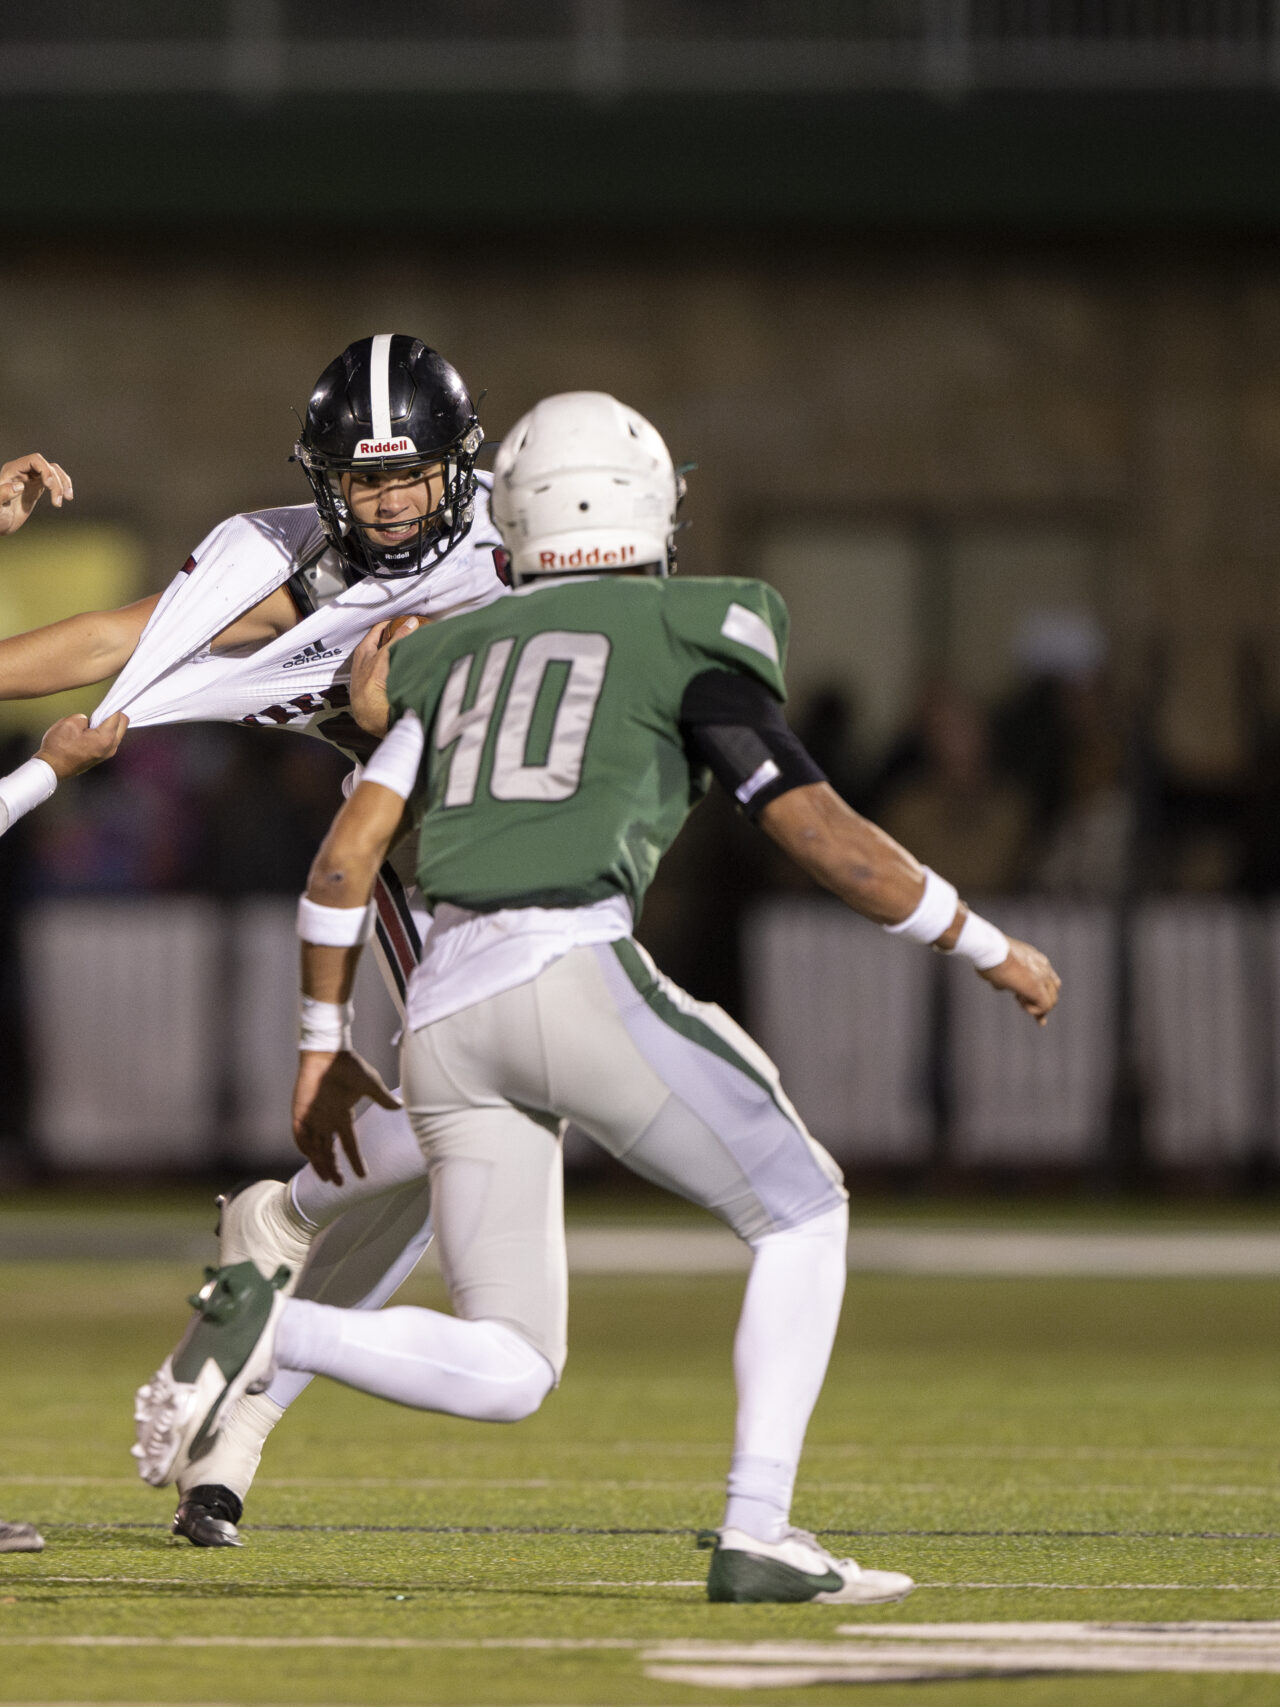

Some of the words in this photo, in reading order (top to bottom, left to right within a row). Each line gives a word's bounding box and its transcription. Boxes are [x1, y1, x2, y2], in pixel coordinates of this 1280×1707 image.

[360, 440, 408, 454] Riddell
[539, 545, 636, 569] Riddell
[282, 648, 343, 669] adidas
[433, 631, 611, 808] 40
